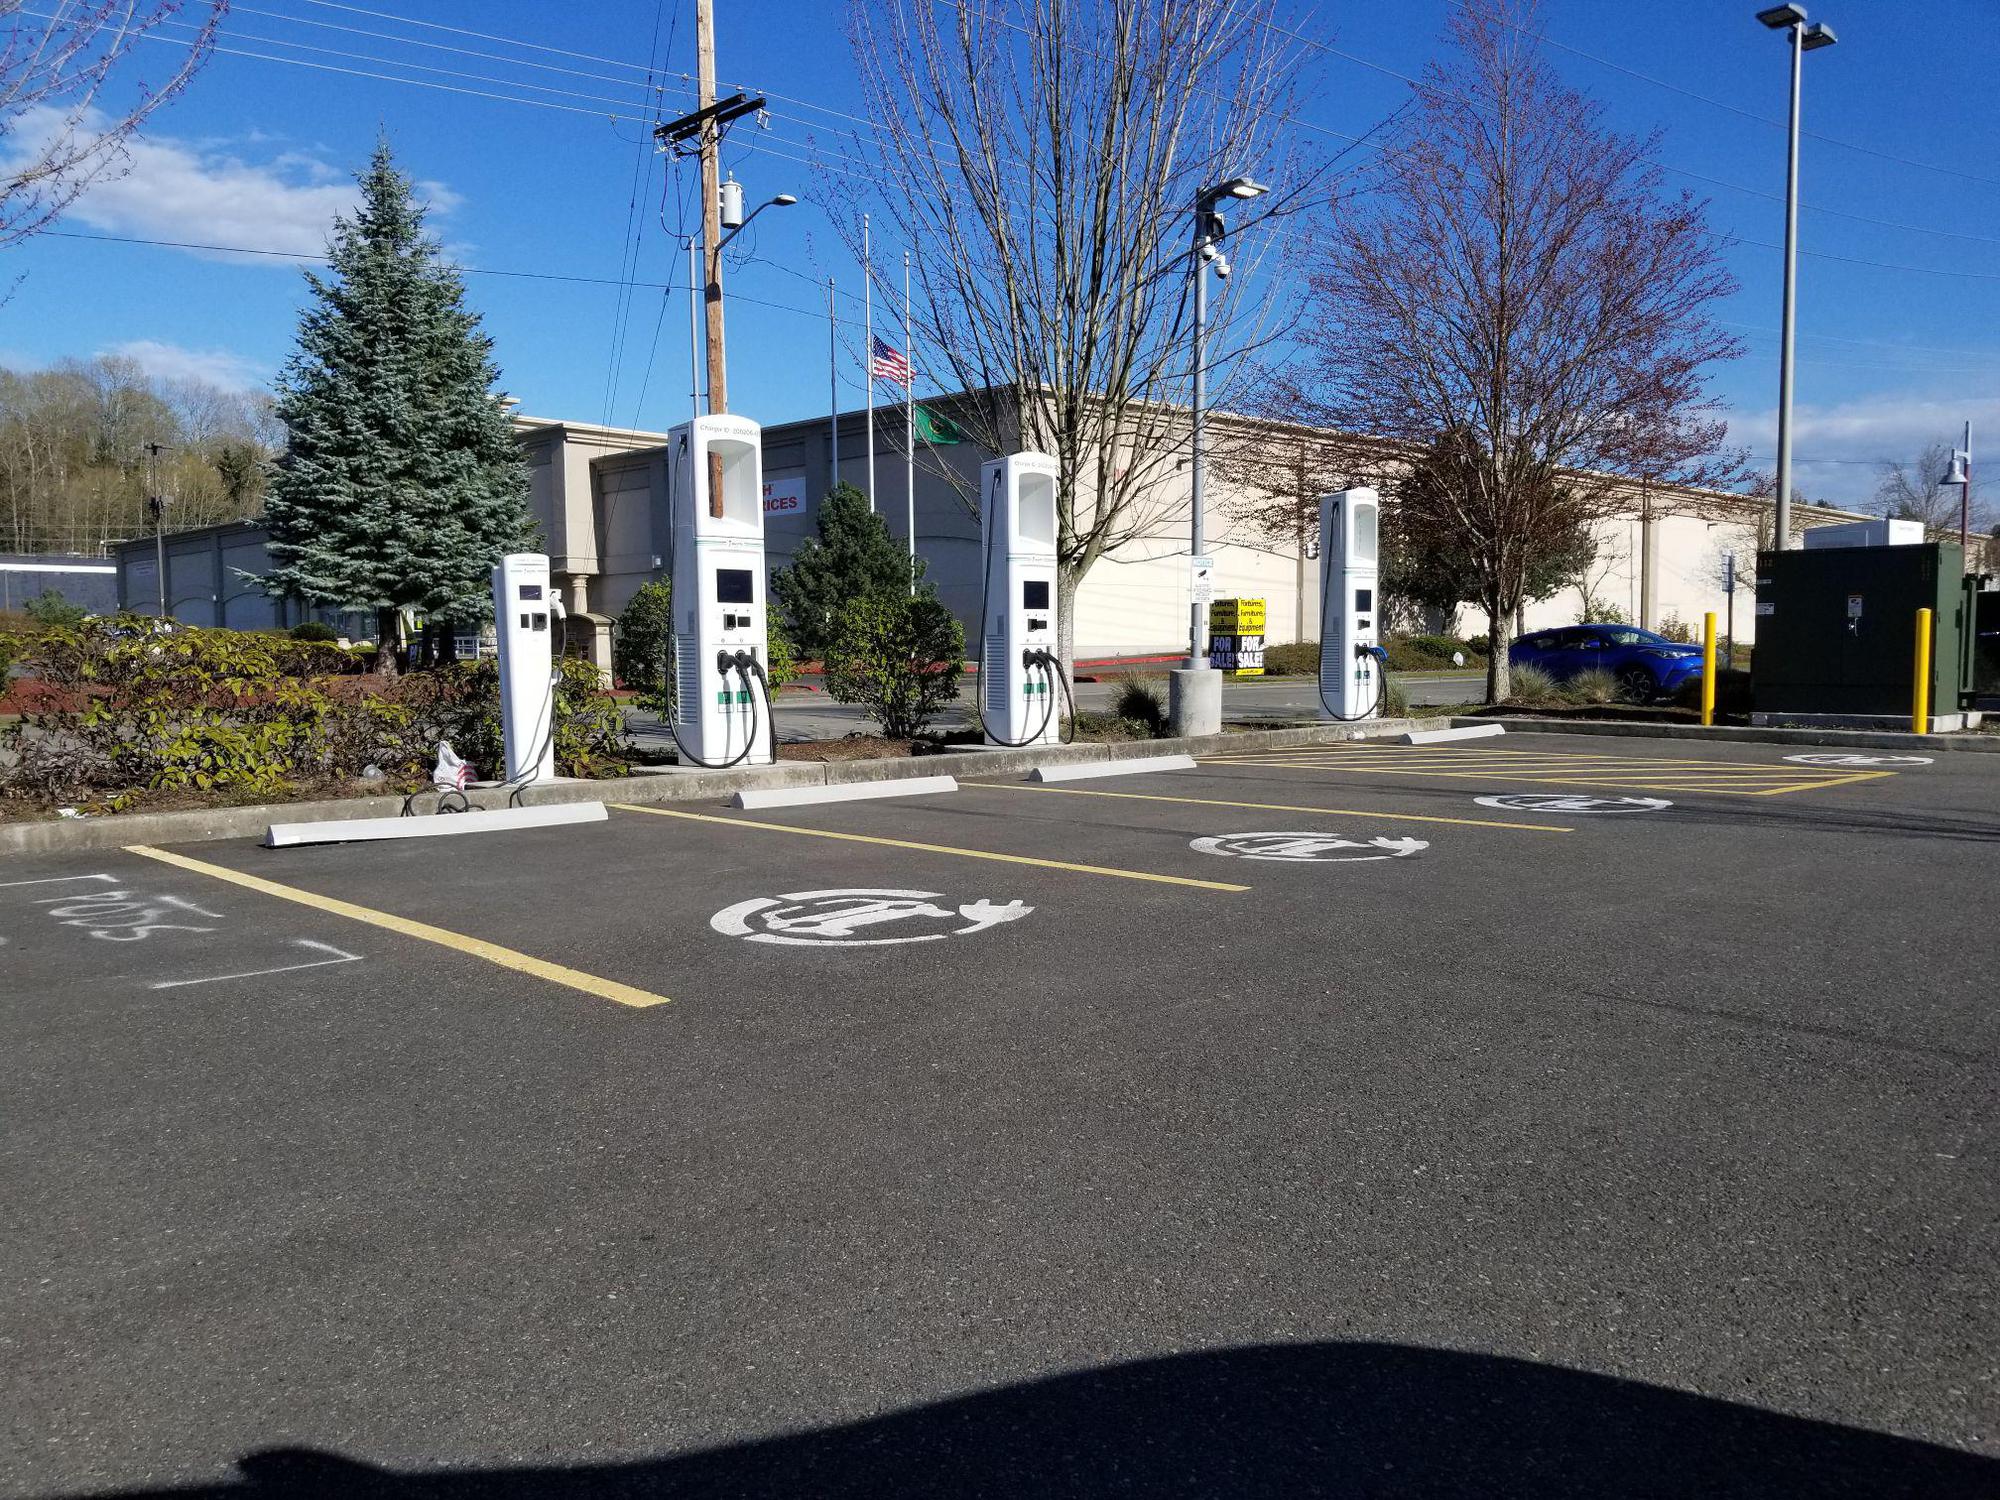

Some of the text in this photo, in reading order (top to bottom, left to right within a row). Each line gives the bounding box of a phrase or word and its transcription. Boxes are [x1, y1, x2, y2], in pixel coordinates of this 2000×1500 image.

[1213, 636, 1232, 651] FOR
[1241, 636, 1260, 651] FOR
[1237, 652, 1264, 668] SALE!
